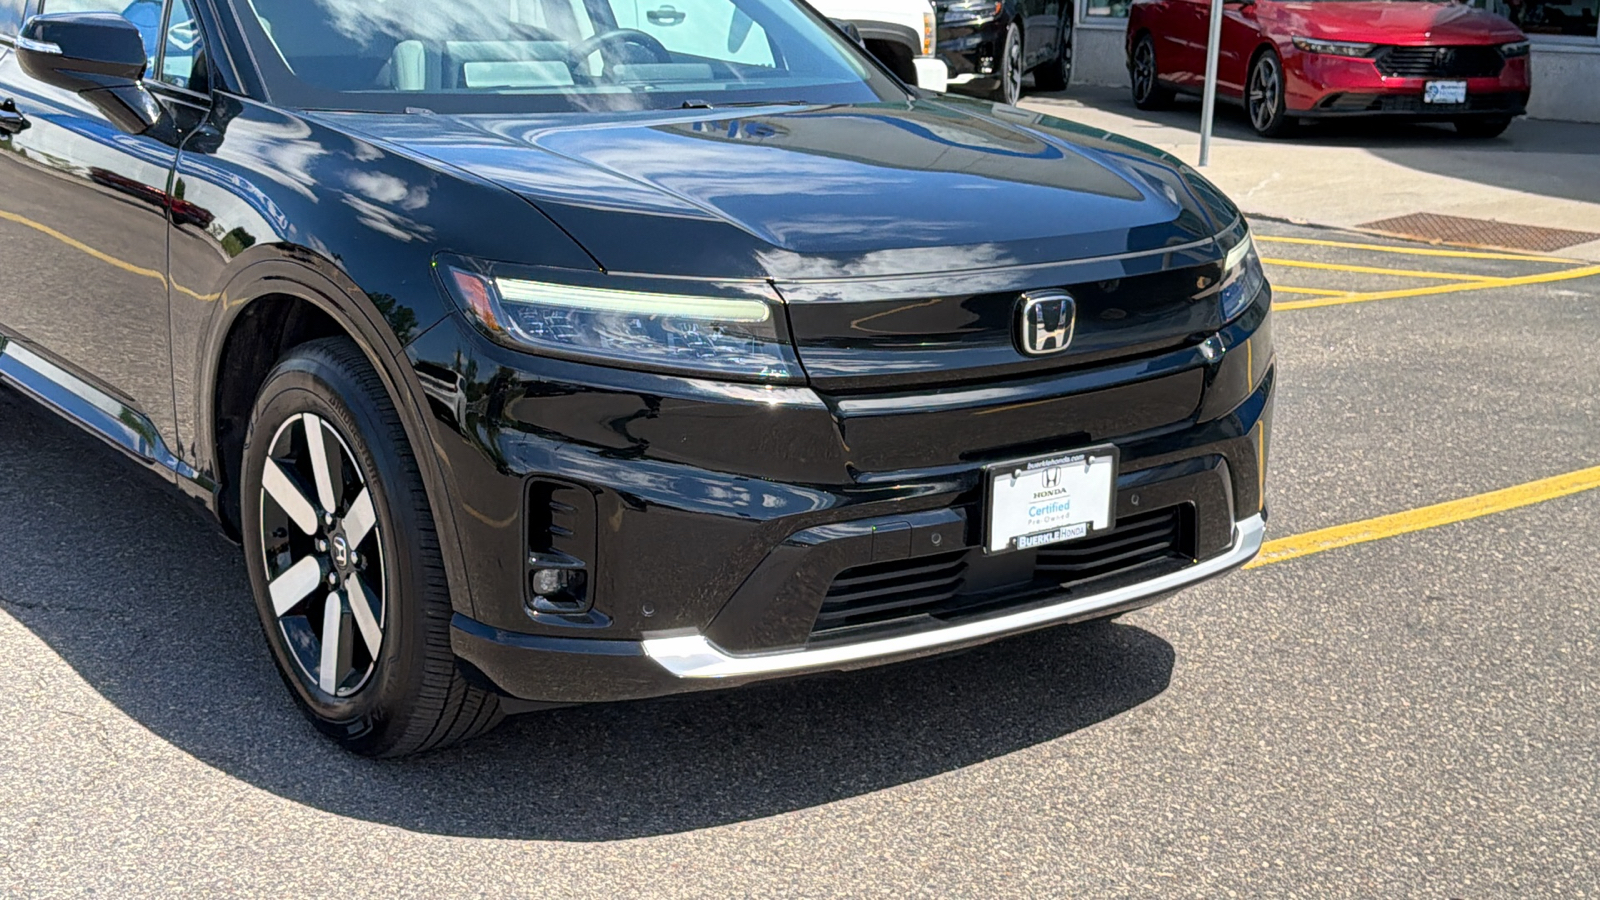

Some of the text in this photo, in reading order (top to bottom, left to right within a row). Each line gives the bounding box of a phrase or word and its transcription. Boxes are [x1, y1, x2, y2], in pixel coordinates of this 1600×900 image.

[1033, 487, 1067, 499] HONDA
[1028, 499, 1070, 518] Certified
[1018, 526, 1084, 549] BUERKLE HONDA
